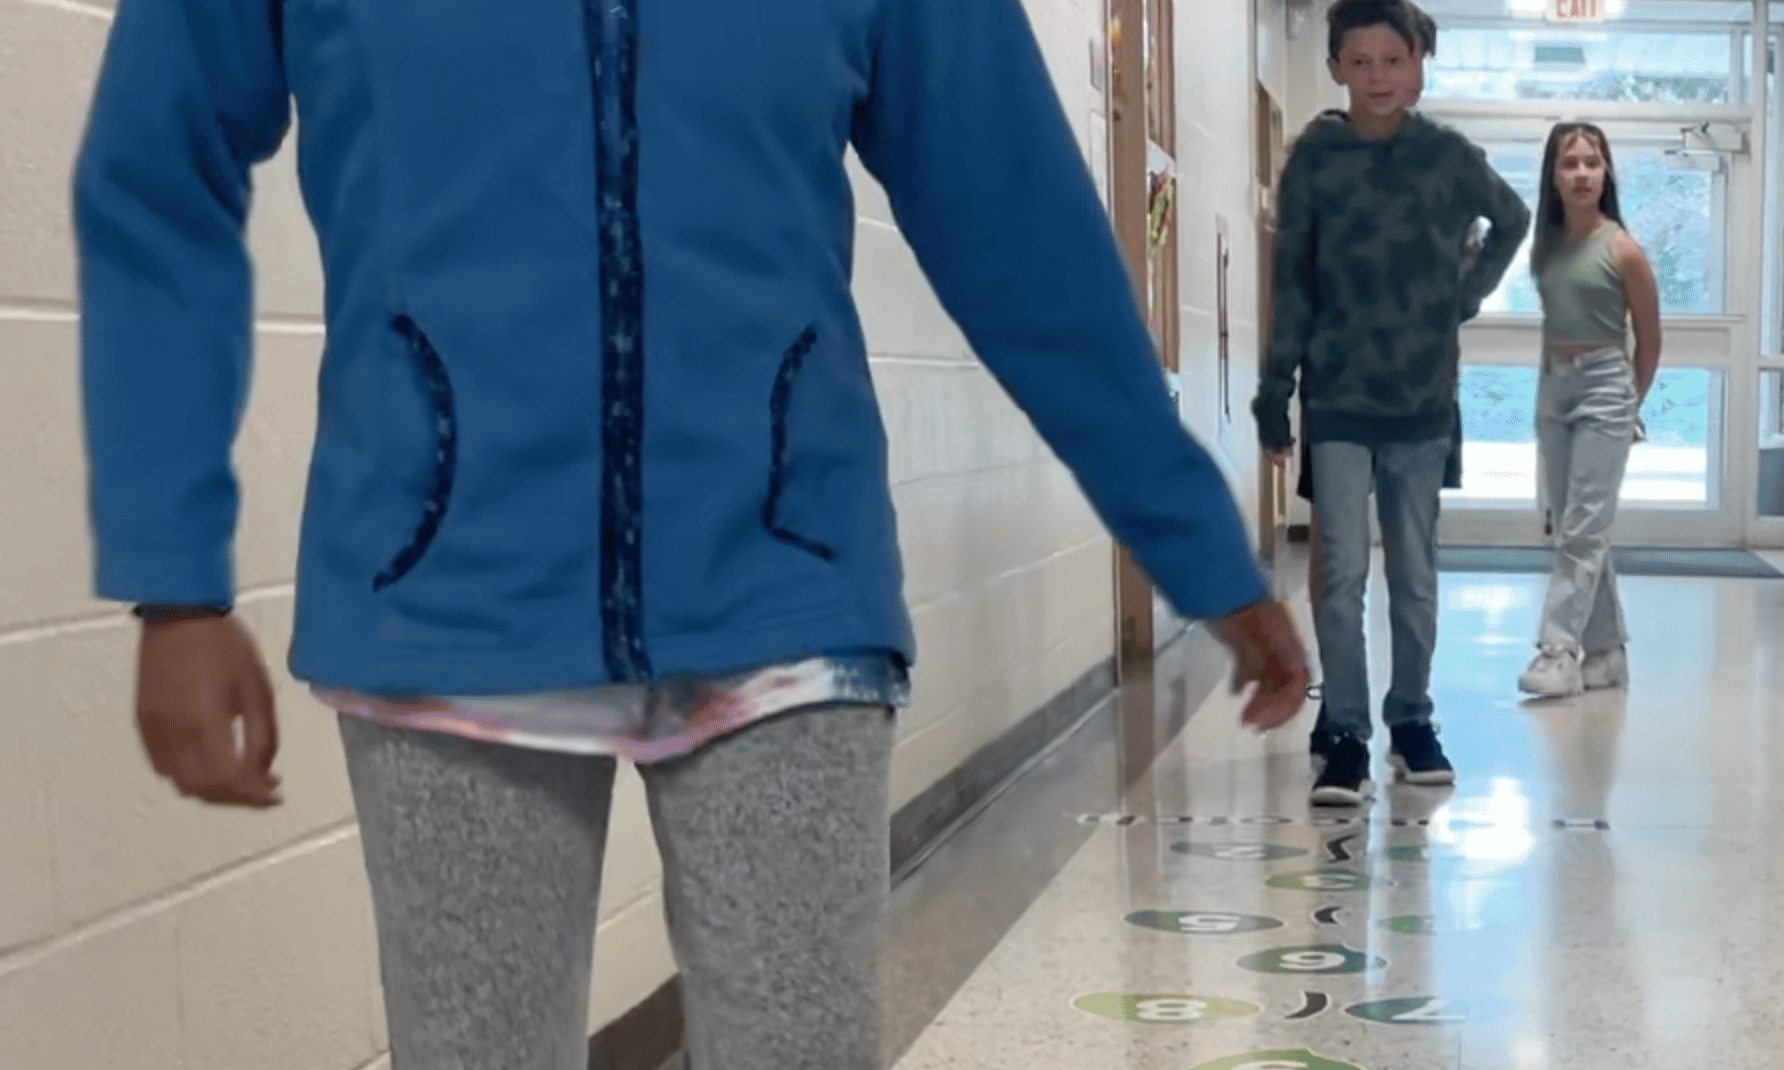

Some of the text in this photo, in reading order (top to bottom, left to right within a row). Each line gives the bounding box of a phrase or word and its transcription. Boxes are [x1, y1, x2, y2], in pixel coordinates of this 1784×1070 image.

[1178, 914, 1241, 932] 5
[1136, 998, 1208, 1021] 8
[1392, 998, 1467, 1021] 7
